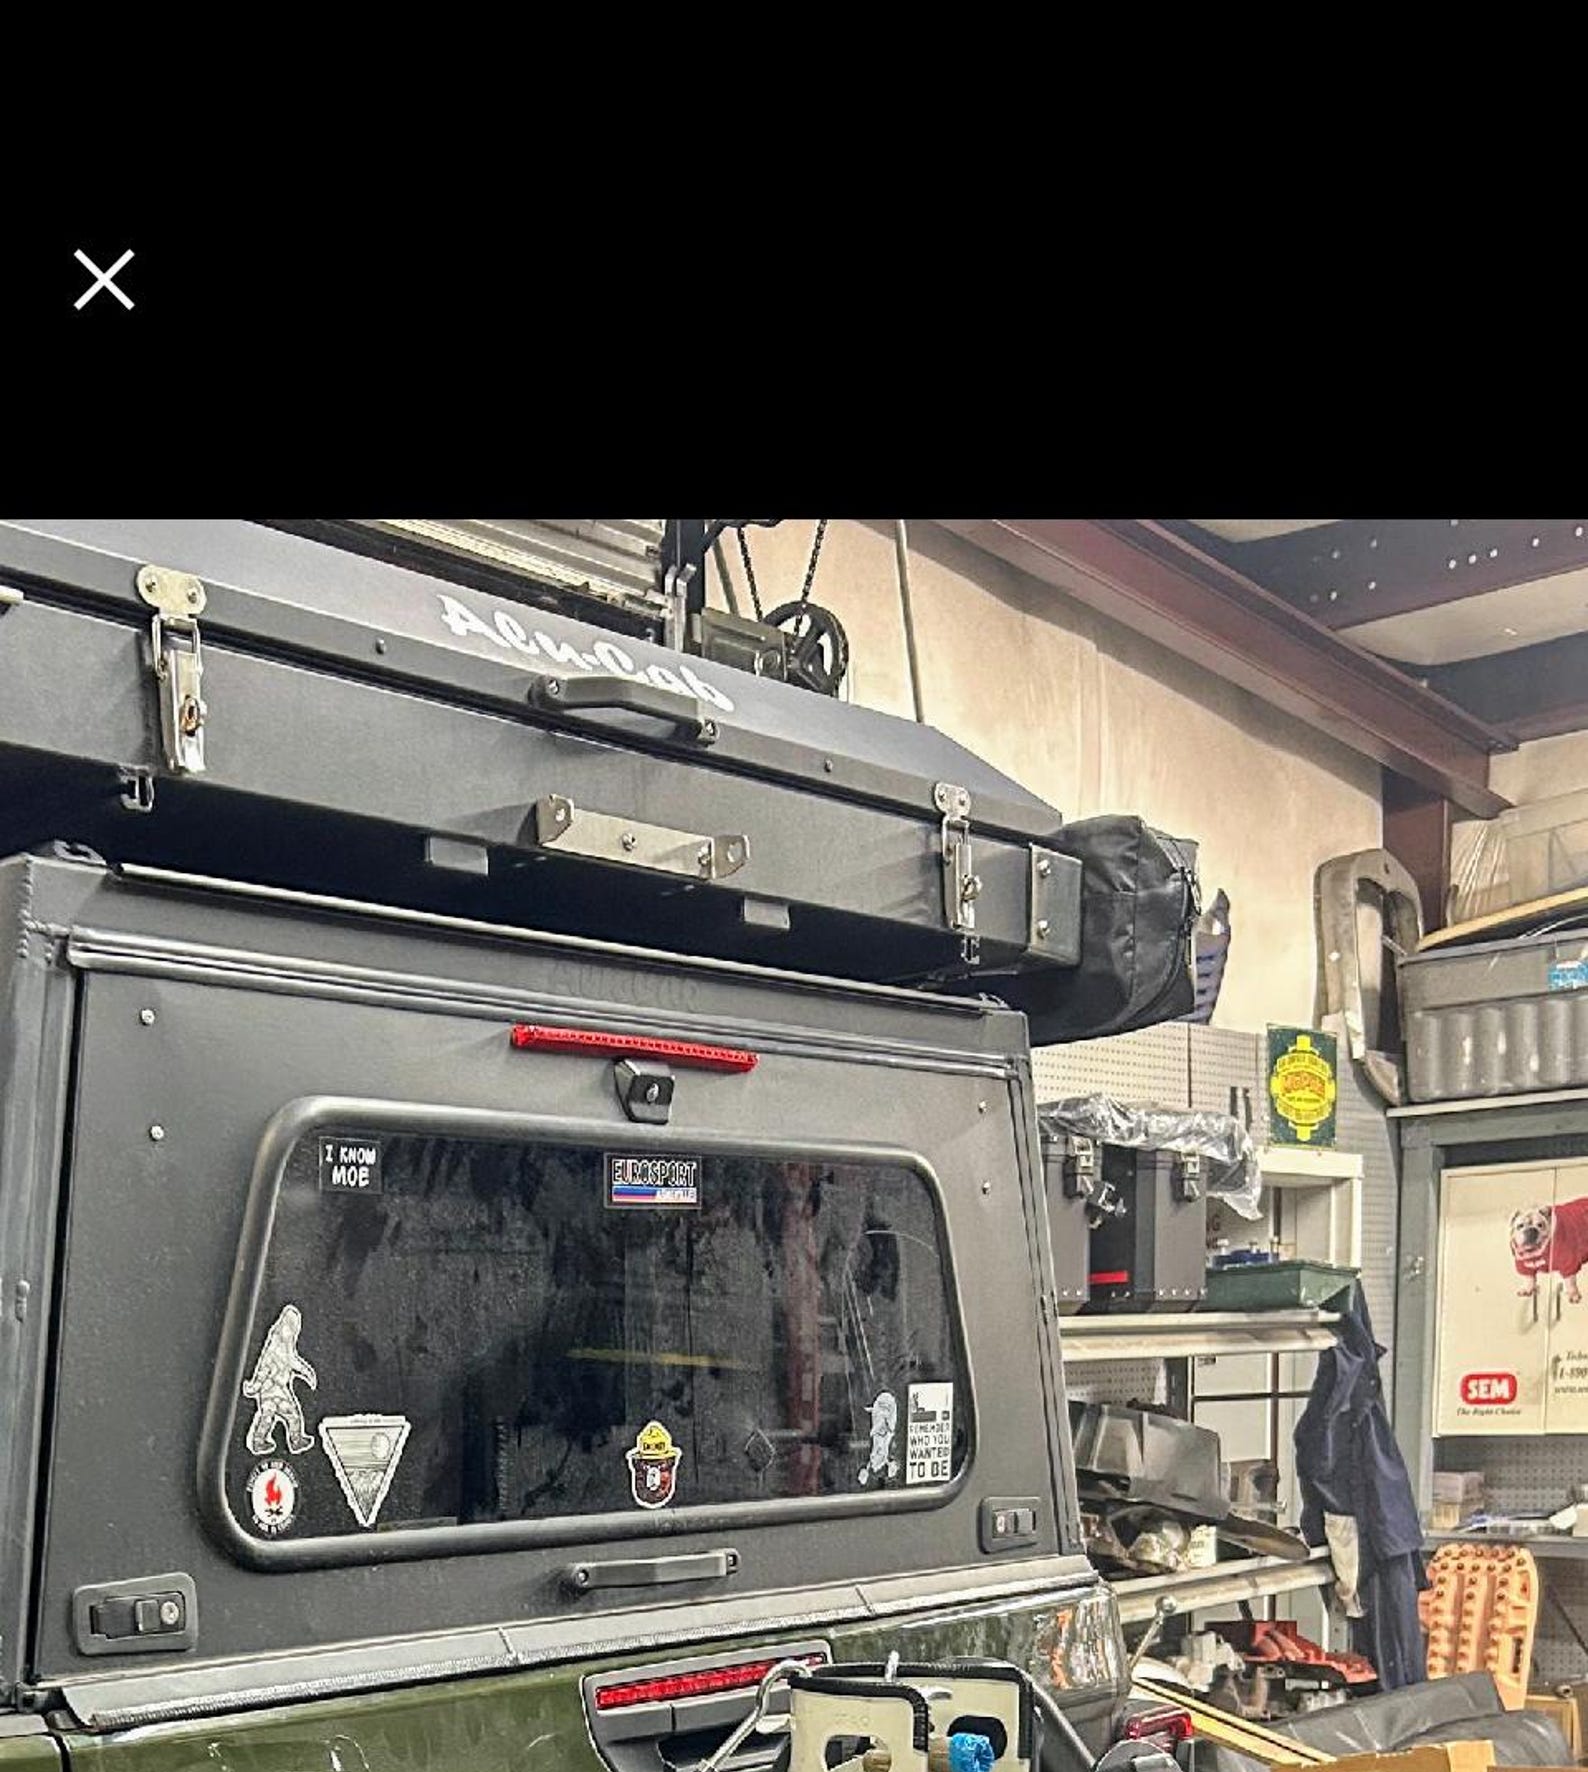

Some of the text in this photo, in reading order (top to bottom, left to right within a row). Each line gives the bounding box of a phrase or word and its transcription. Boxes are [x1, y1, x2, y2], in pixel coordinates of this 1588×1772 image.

[325, 1144, 377, 1166] I KNOW
[332, 1165, 370, 1187] MOE
[611, 1159, 697, 1187] EUROSPORT
[1467, 1378, 1510, 1400] SEM
[909, 1433, 950, 1447] WHO YOU
[909, 1446, 950, 1460] WANTED
[909, 1460, 949, 1479] TO BE
